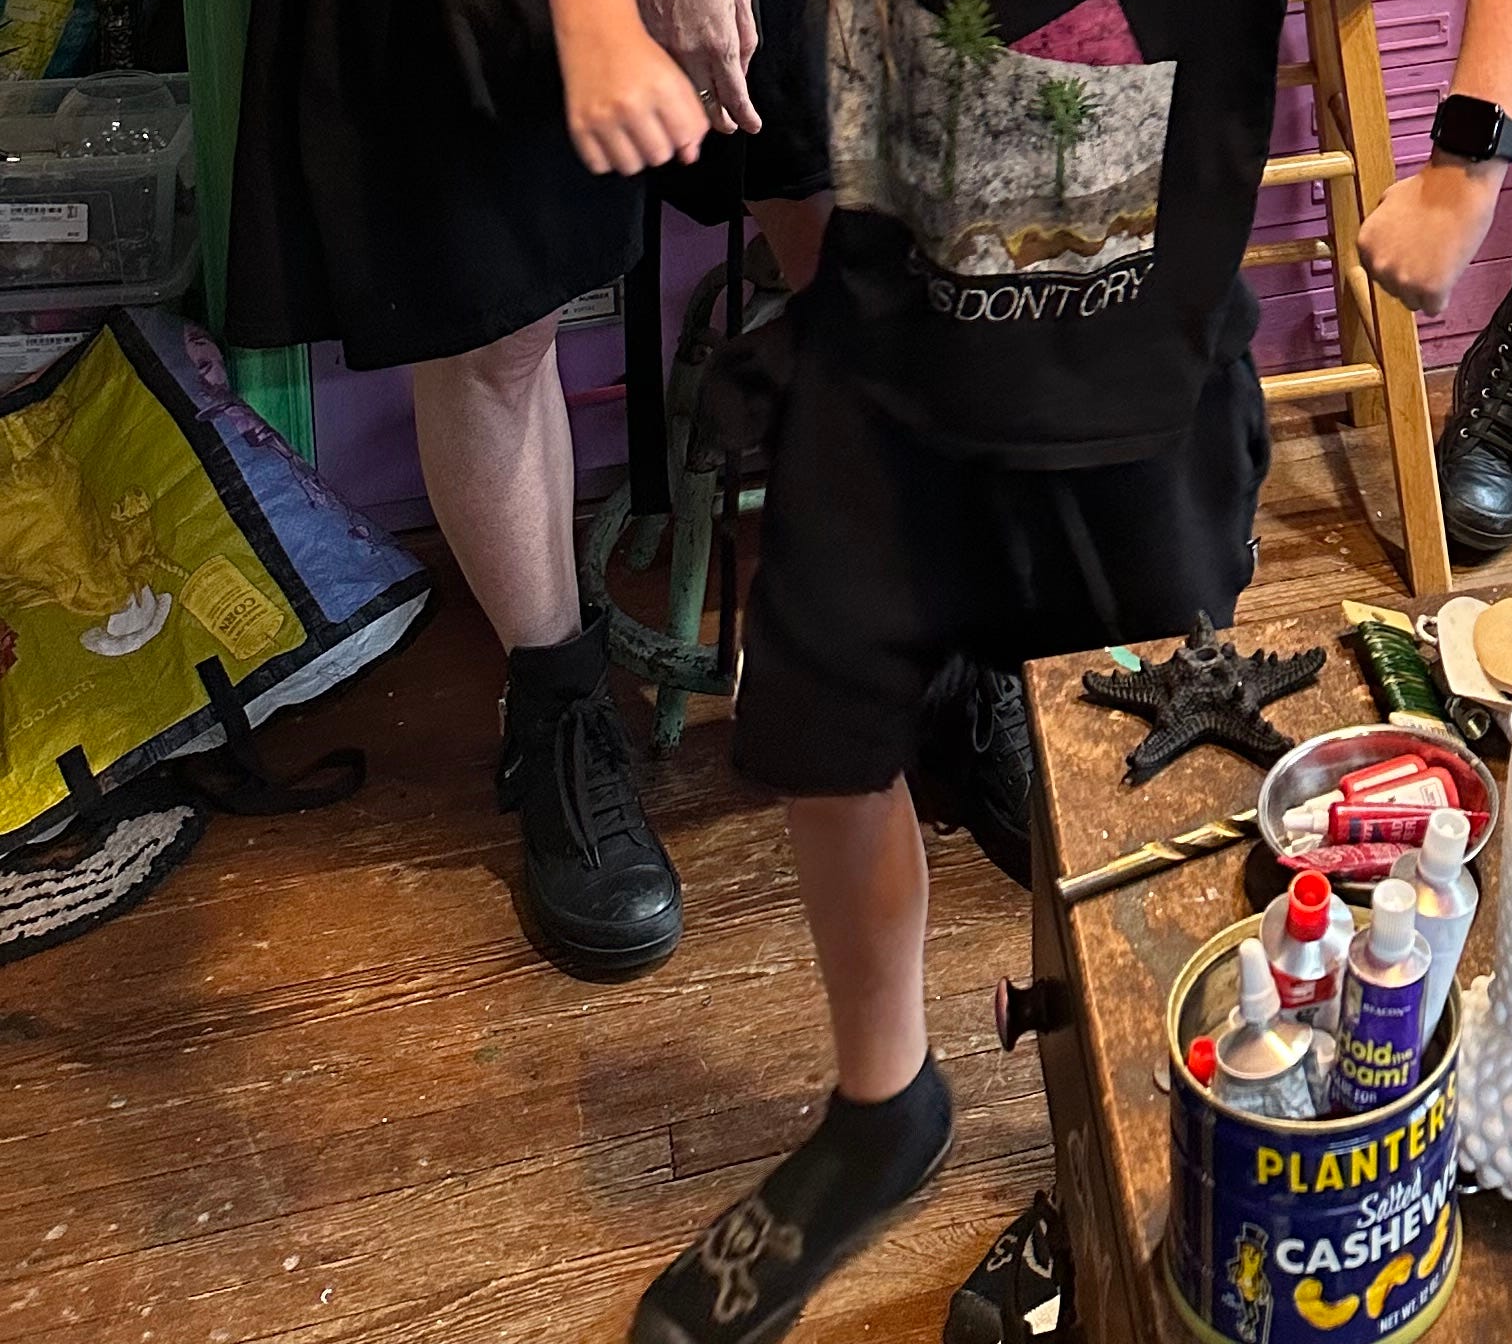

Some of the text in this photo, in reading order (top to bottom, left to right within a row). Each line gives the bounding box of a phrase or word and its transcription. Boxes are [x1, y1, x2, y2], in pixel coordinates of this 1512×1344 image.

[954, 262, 1155, 321] DON'T CRY
[218, 597, 256, 634] CORN
[1342, 1057, 1410, 1089] oam!
[1275, 1156, 1458, 1274] CASHEWS
[1356, 1166, 1424, 1230] Salted
[1379, 1313, 1402, 1334] NET
